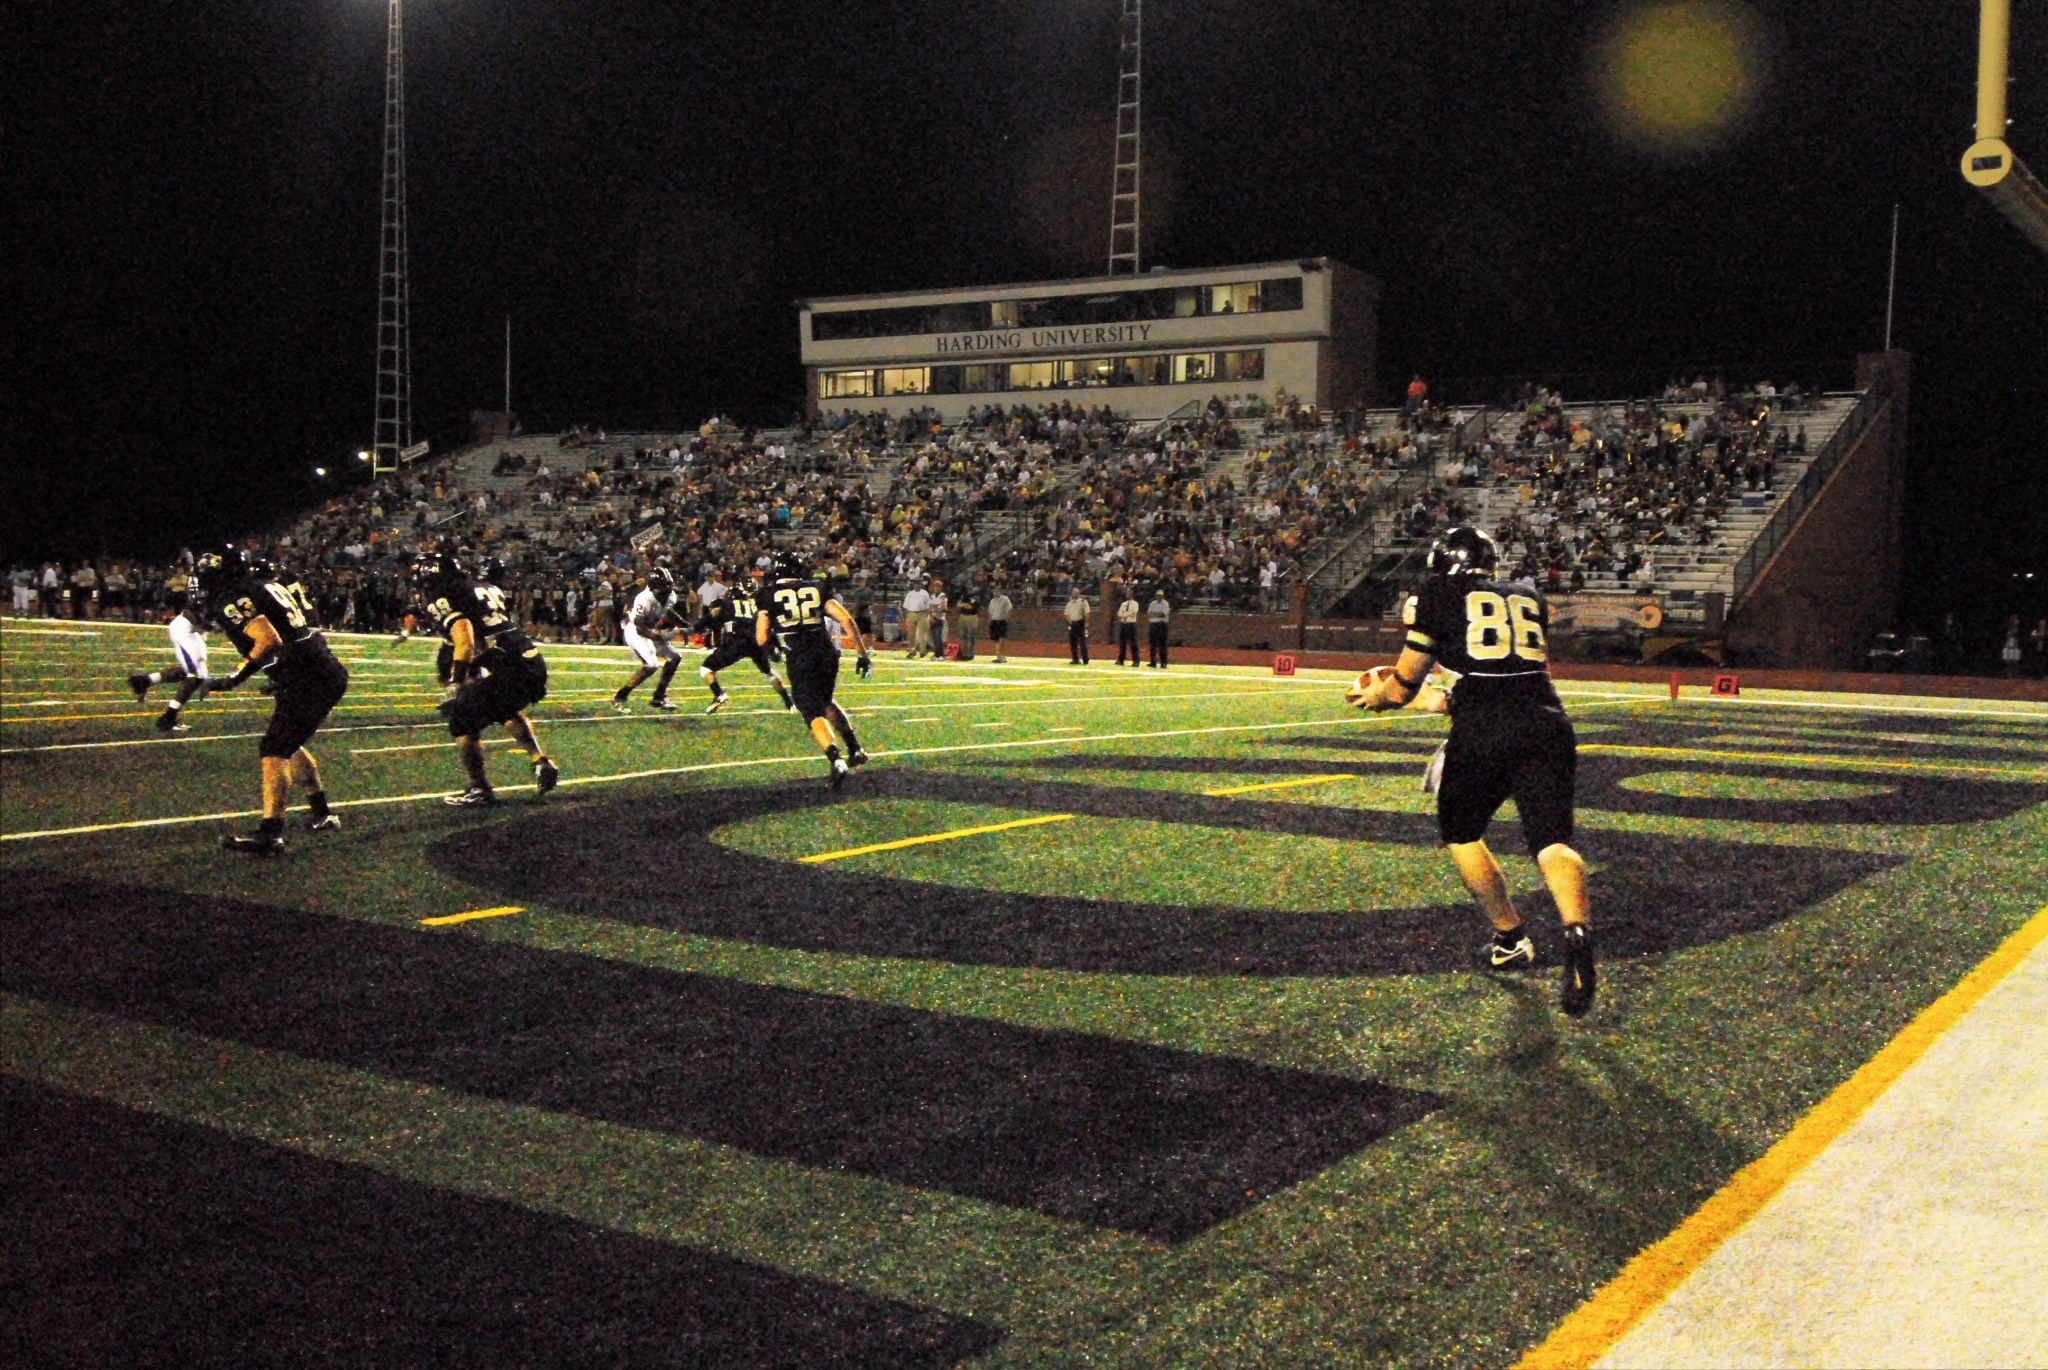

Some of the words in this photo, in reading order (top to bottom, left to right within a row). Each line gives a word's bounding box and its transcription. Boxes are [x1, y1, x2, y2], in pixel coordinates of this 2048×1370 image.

[937, 332, 1021, 351] HARDING
[1032, 324, 1152, 347] UNIVERSITY
[774, 586, 821, 628] 32
[1466, 590, 1547, 663] 86
[1278, 657, 1292, 673] 10
[1717, 677, 1733, 693] G
